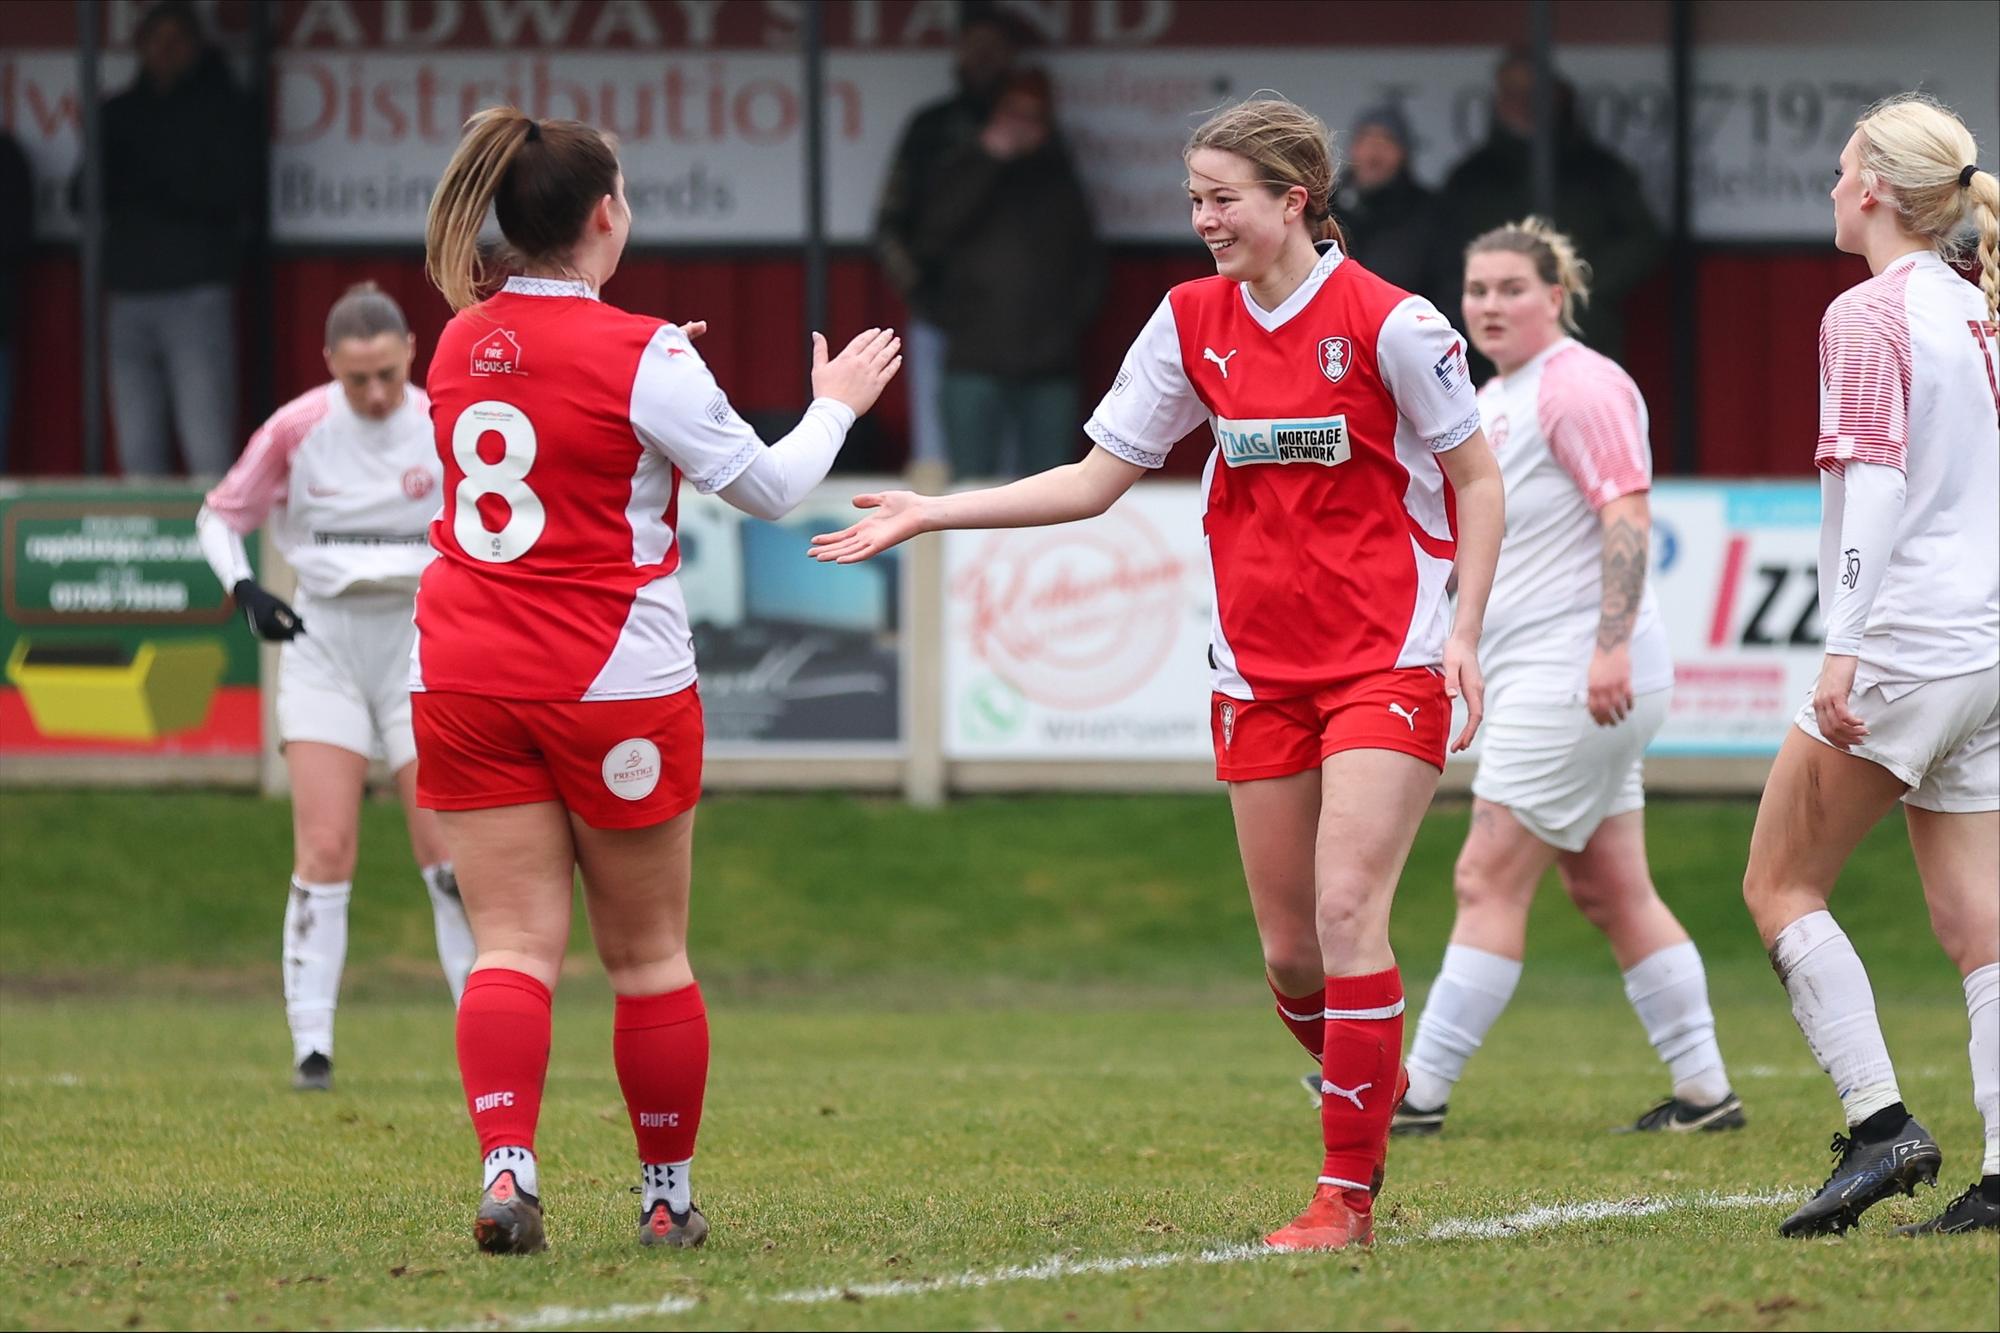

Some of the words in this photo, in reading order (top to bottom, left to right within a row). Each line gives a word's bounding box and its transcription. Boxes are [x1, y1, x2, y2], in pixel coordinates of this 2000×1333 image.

[268, 56, 864, 147] Distribution
[484, 348, 504, 359] FIRE
[474, 359, 512, 374] HOUSE
[1219, 429, 1270, 456] TMG
[1277, 427, 1342, 447] MORTGAGE
[1279, 445, 1337, 462] NETWORK
[452, 400, 546, 564] 8
[613, 766, 654, 781] PRESTIGE
[475, 1091, 515, 1113] RUFC
[640, 1112, 679, 1128] RUFC
